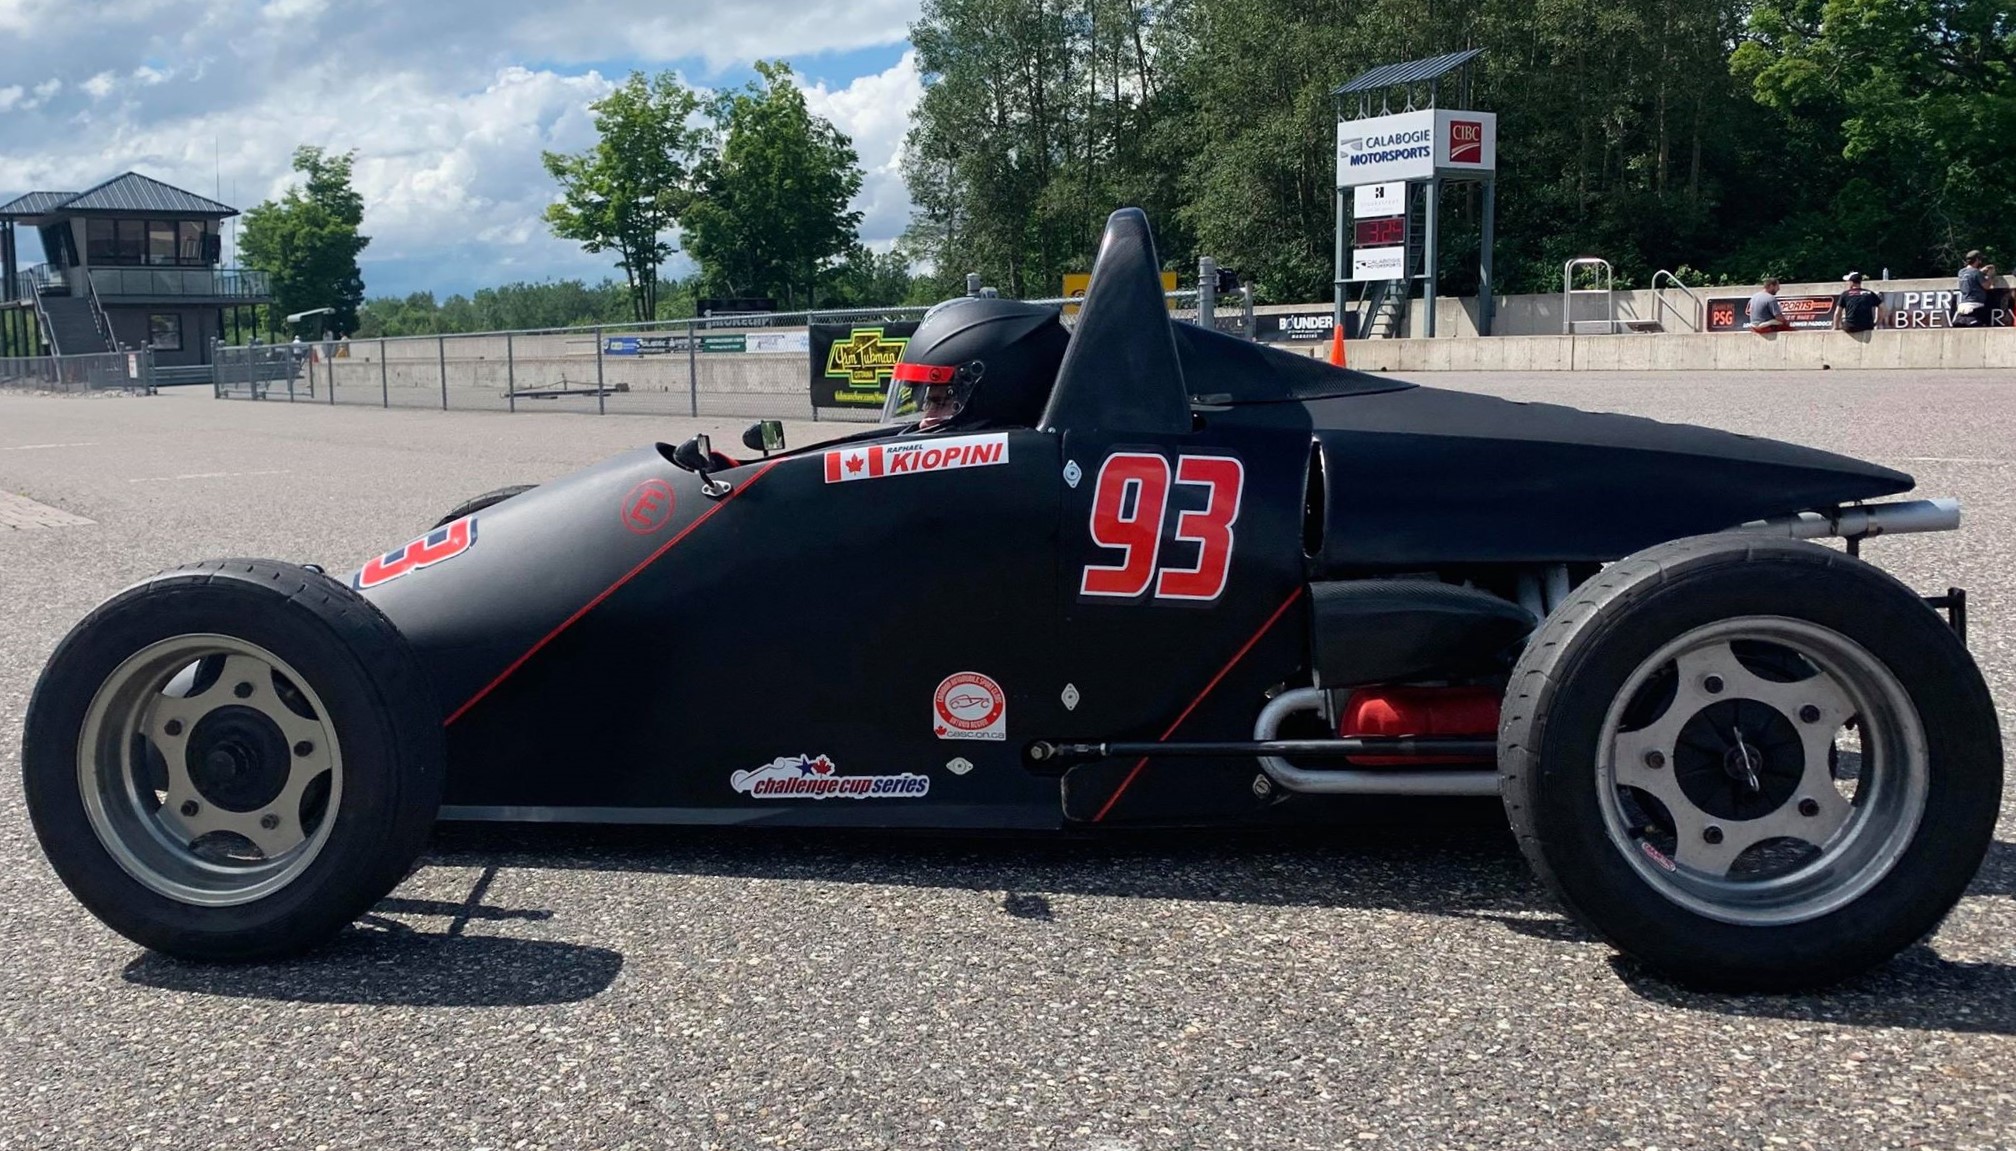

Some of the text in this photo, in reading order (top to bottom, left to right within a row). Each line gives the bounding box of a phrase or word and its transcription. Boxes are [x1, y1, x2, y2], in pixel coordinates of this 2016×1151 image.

[1366, 129, 1430, 149] CALABOGIE
[1452, 125, 1480, 141] CIBC
[1350, 145, 1430, 166] MOTORSPORTS
[1780, 302, 1812, 310] PORTS
[1903, 291, 1964, 310] PERT
[1279, 315, 1333, 330] BOUNDER
[1713, 311, 1732, 325] PSG
[835, 338, 896, 370] Jim Tubman
[887, 444, 924, 453] RAPHAEL
[890, 442, 1003, 474] KIOPINI
[1080, 452, 1244, 600] 93
[753, 776, 838, 796] challenge
[872, 774, 928, 793] series
